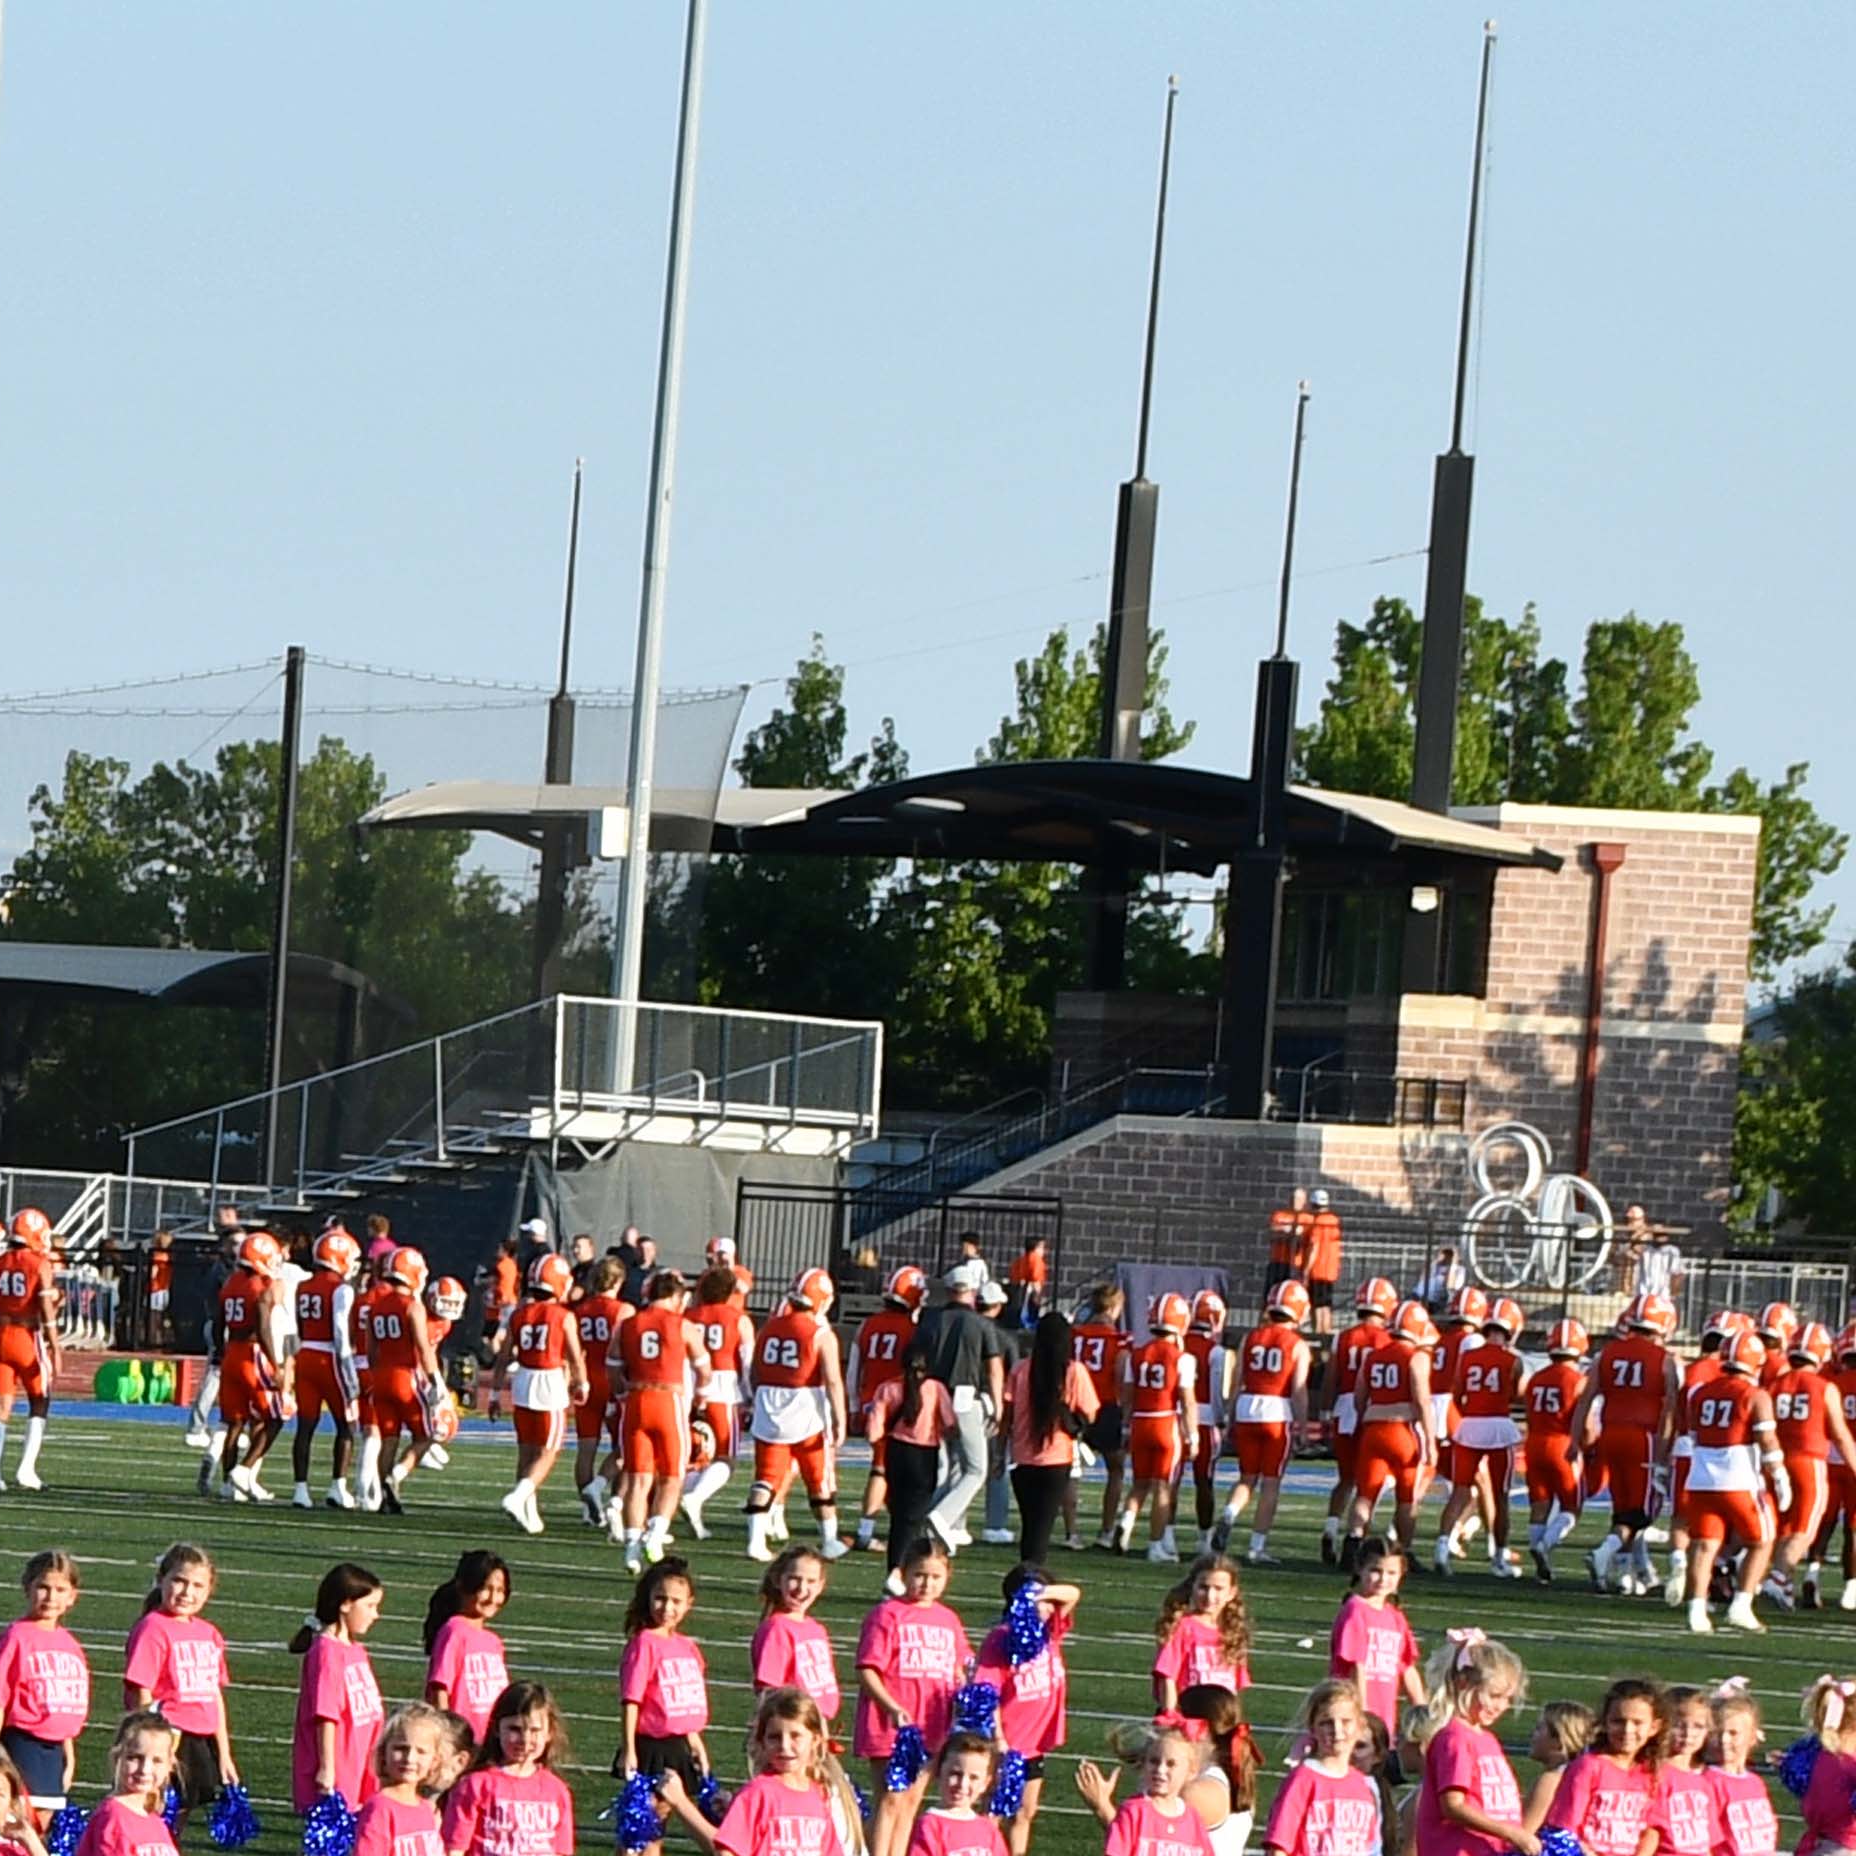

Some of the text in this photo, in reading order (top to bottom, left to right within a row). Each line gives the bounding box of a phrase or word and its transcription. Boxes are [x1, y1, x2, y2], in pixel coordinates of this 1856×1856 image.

[225, 1298, 244, 1322] 95
[299, 1294, 322, 1319] 23
[374, 1315, 402, 1339] 80
[520, 1324, 549, 1351] 67
[580, 1317, 609, 1341] 28
[641, 1330, 660, 1359] 6
[764, 1337, 800, 1369] 62
[868, 1333, 897, 1360] 17
[1074, 1336, 1105, 1371] 13
[1250, 1345, 1283, 1373] 30
[1138, 1361, 1165, 1389] 13
[1370, 1363, 1399, 1389] 50
[1466, 1365, 1499, 1393] 24
[1612, 1360, 1643, 1387] 71
[1532, 1386, 1560, 1413] 75
[1776, 1393, 1810, 1420] 65
[1700, 1400, 1733, 1428] 97
